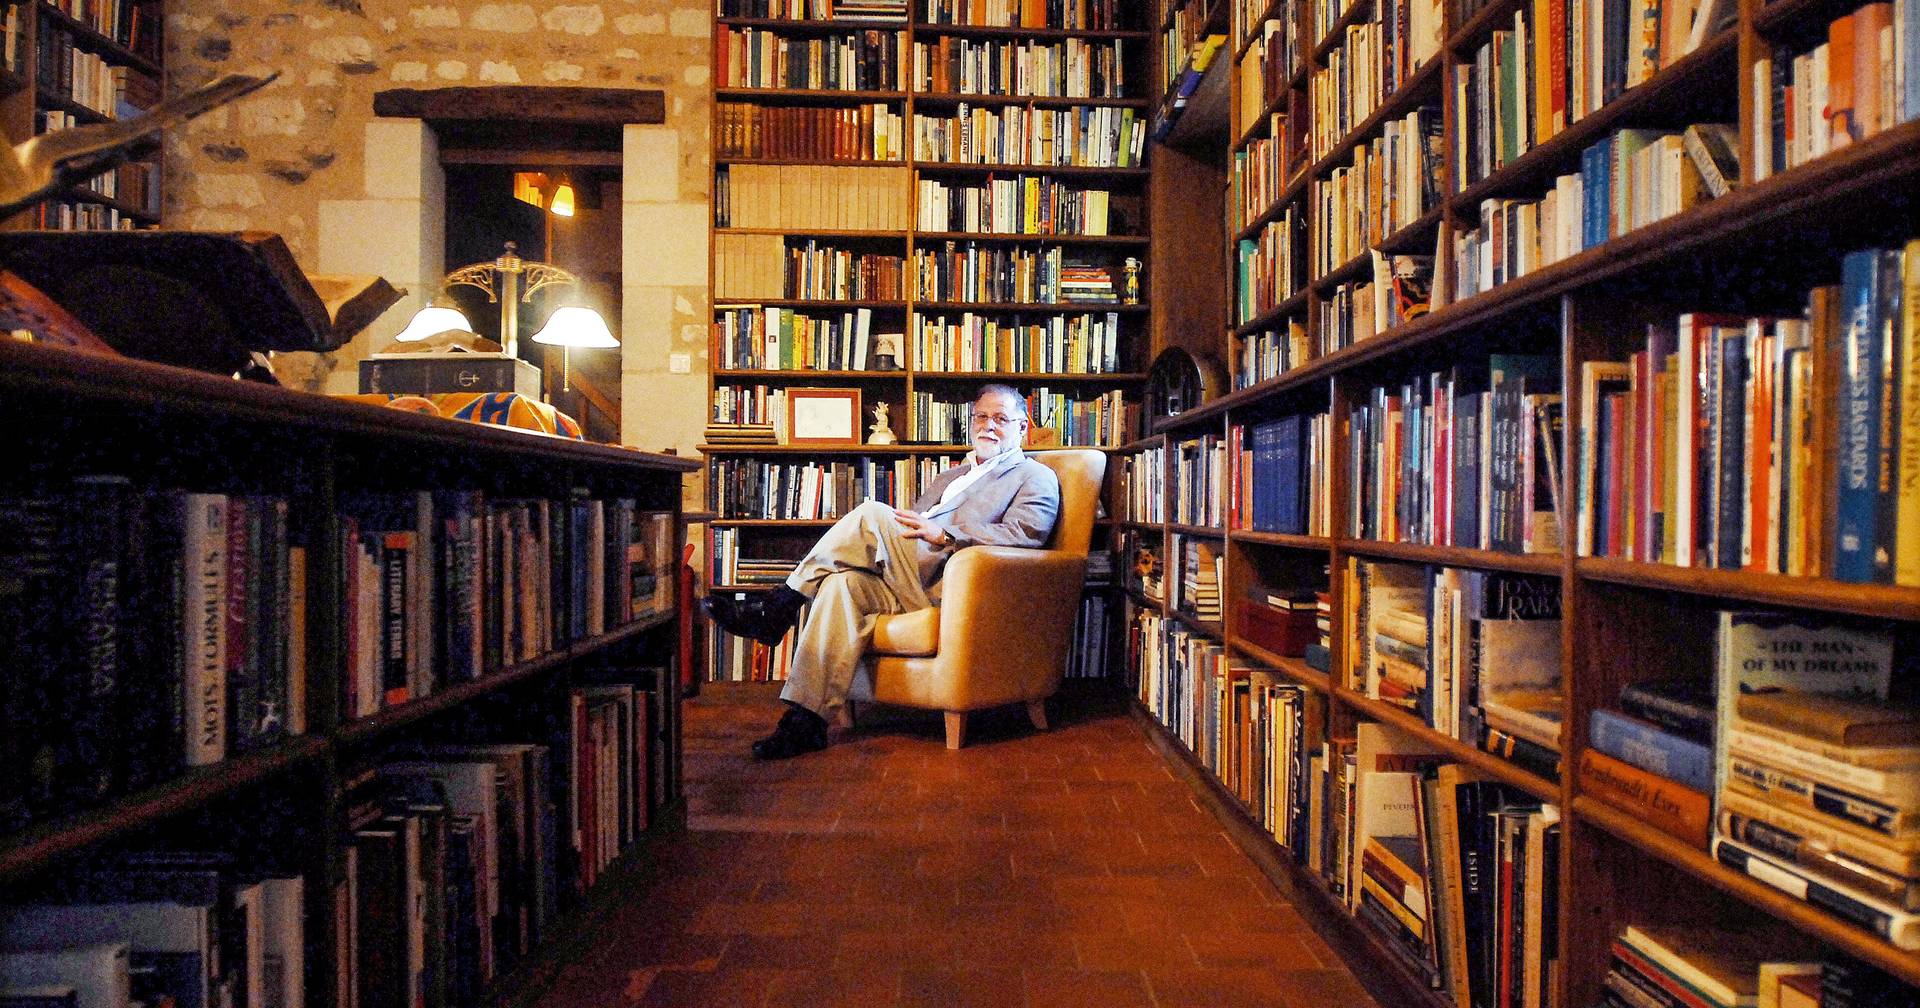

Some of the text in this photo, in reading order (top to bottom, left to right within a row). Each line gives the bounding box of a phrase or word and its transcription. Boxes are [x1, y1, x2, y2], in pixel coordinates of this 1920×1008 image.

[1848, 399, 1870, 490] BASTARDS
[389, 559, 404, 660] LITERARY TERMS
[1743, 658, 1880, 674] OF MY DREAMS
[1772, 641, 1854, 655] THE MAN
